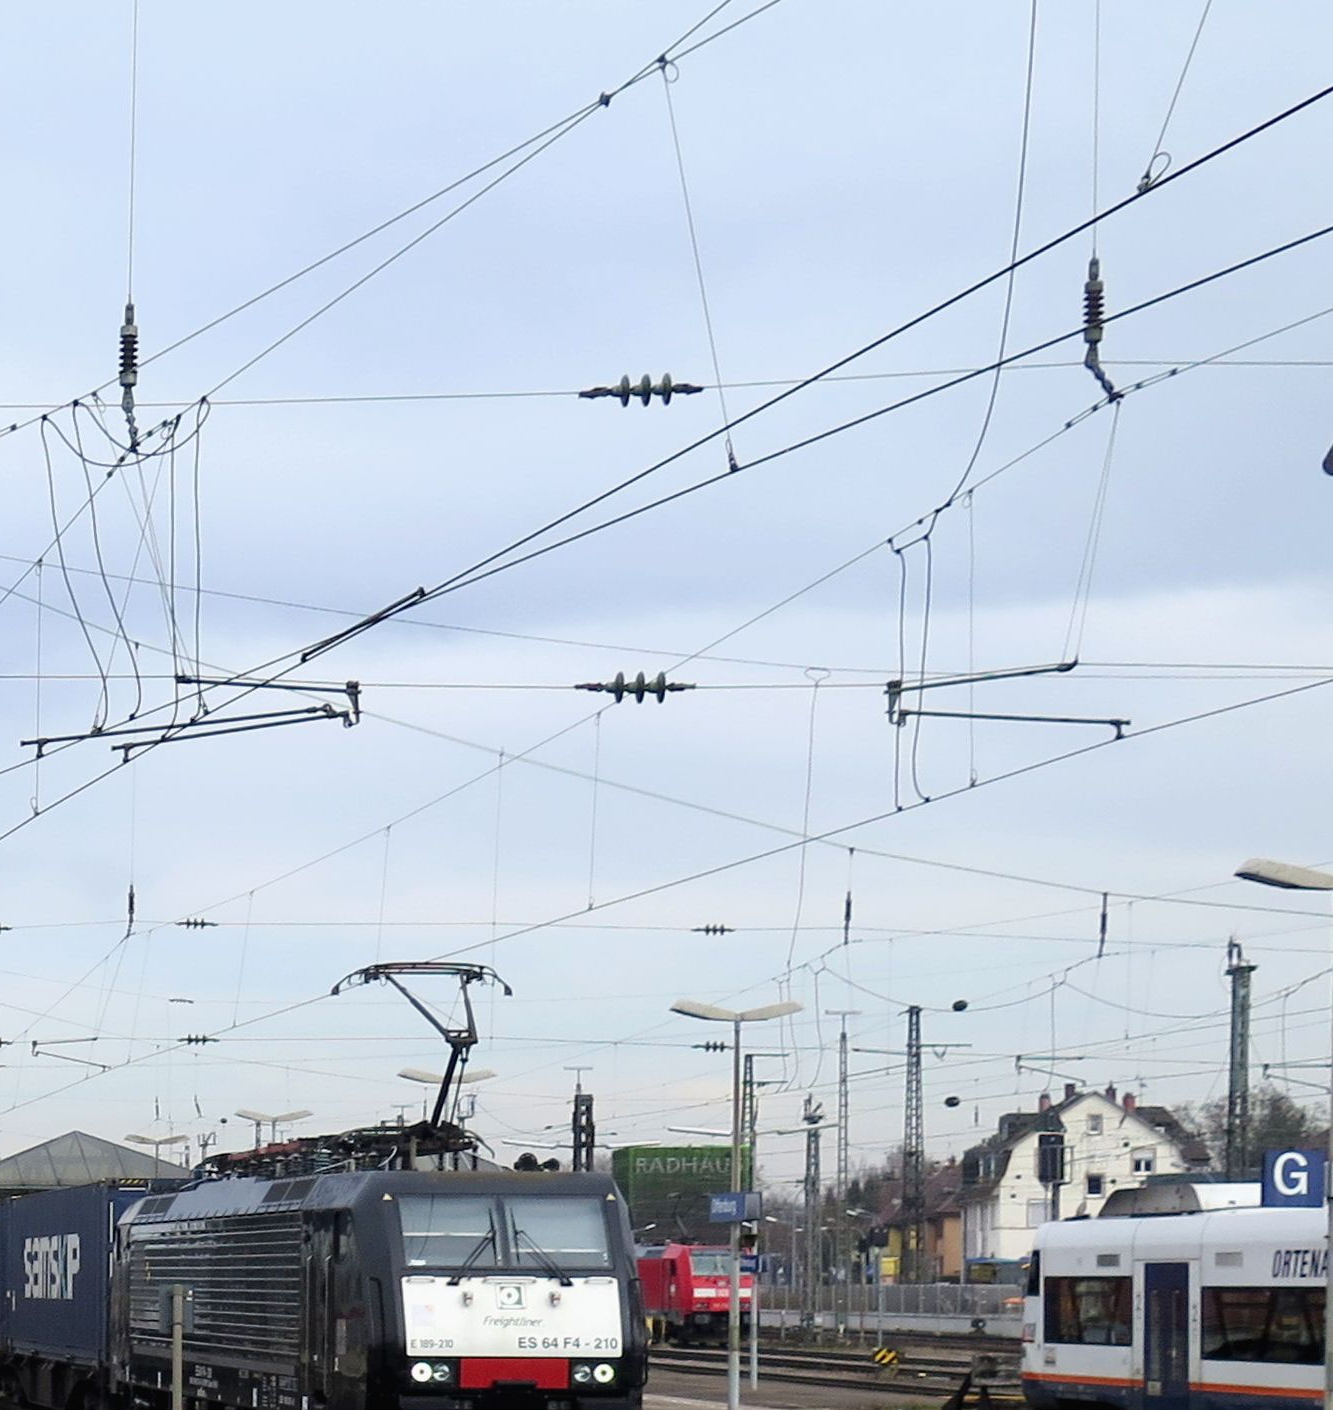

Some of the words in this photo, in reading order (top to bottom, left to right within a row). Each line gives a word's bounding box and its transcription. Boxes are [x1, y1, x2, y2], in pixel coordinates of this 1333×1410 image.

[635, 1157, 731, 1174] RADHAU
[1273, 1152, 1309, 1196] G
[410, 1339, 416, 1349] E
[518, 1337, 538, 1349] ES
[542, 1337, 559, 1349] 64
[563, 1337, 581, 1349] F4
[594, 1337, 618, 1349] 210
